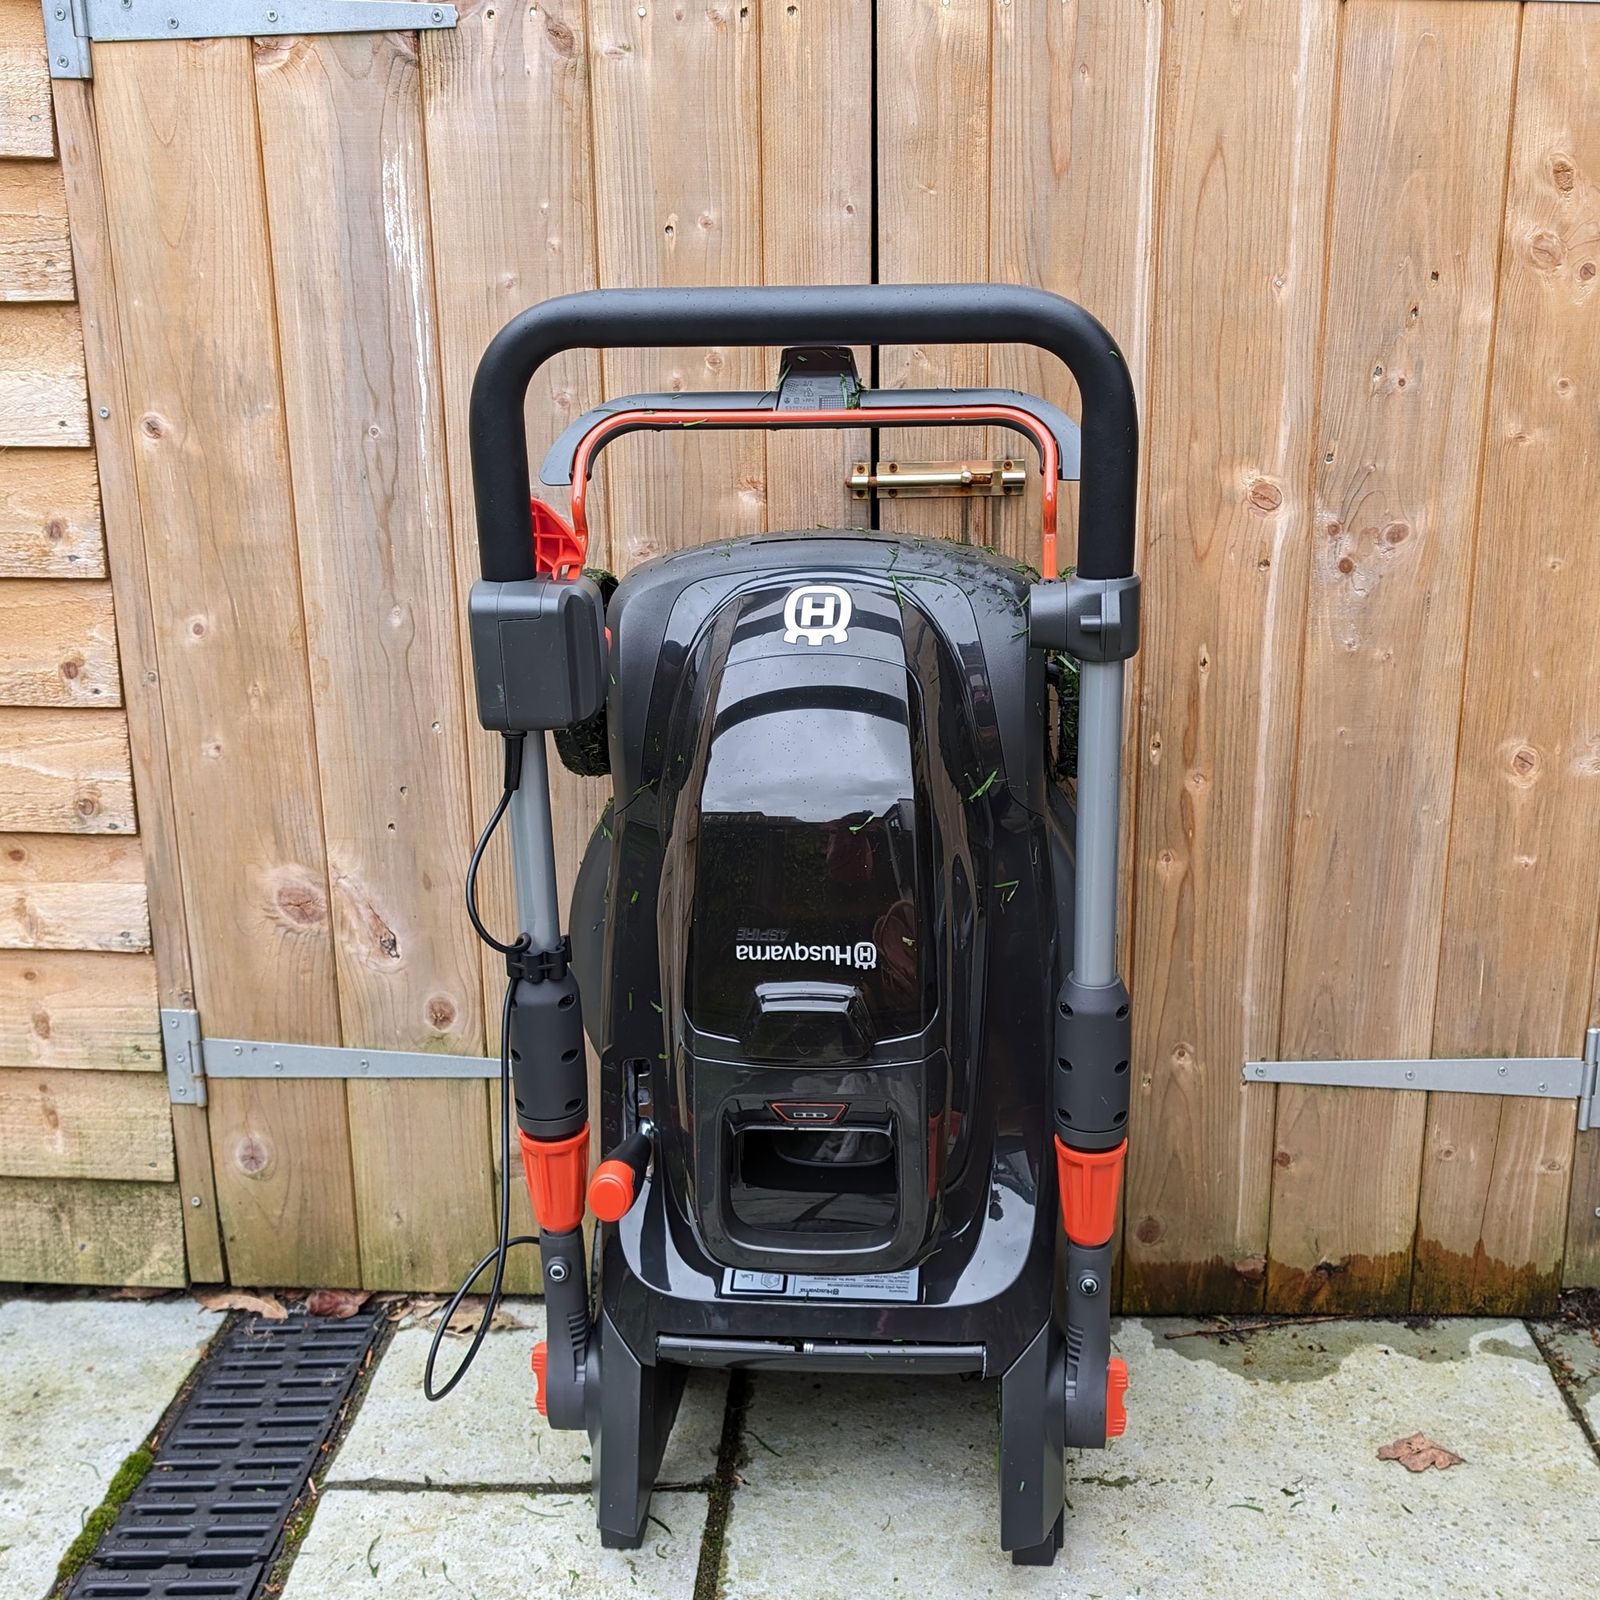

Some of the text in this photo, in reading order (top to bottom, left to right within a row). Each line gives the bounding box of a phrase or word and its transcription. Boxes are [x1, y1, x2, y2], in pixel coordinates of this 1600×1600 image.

[736, 928, 789, 942] ASPIRE
[736, 942, 852, 966] Husqvarna
[800, 1287, 832, 1295] Husqvarna
